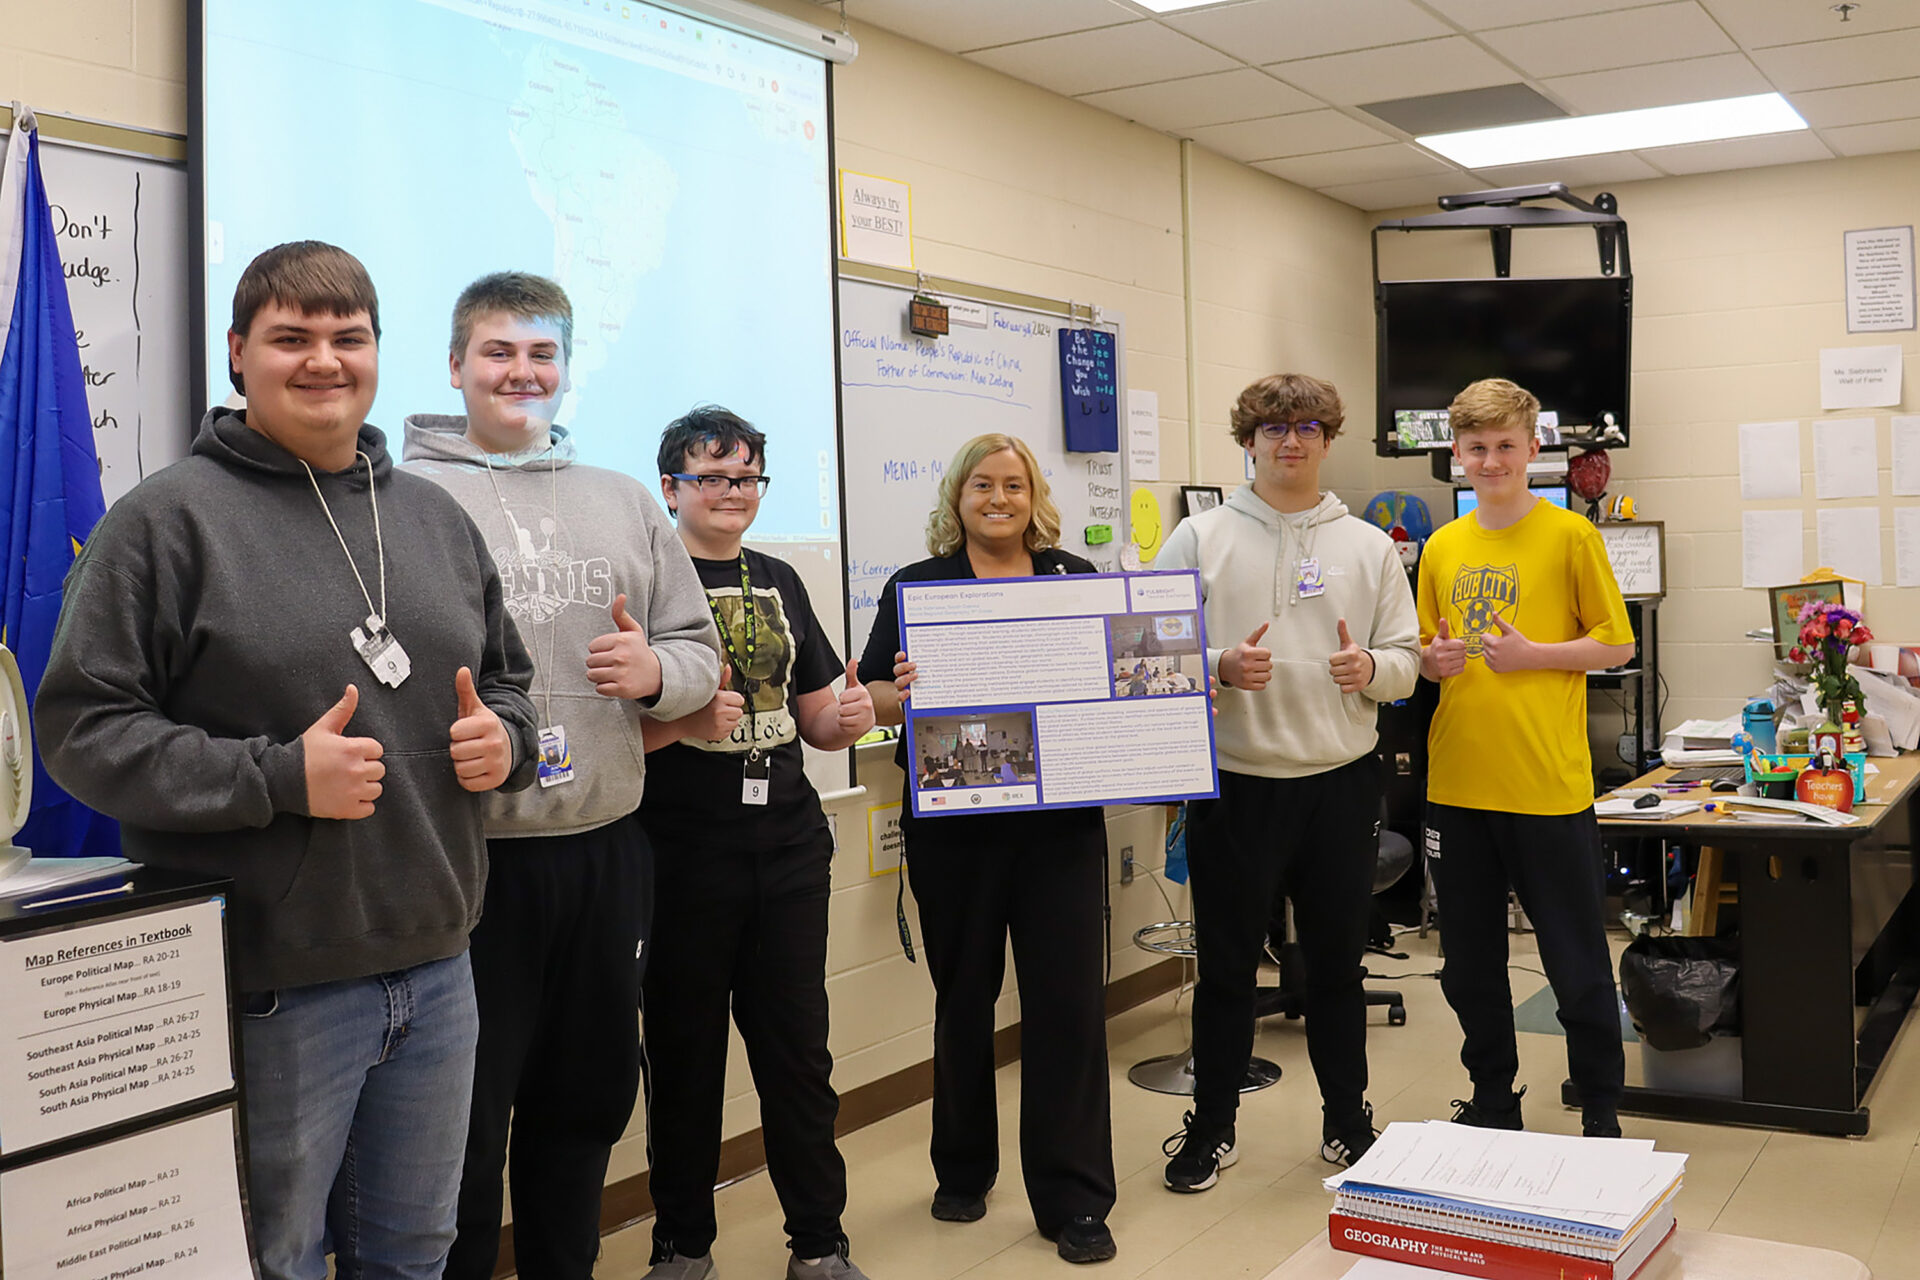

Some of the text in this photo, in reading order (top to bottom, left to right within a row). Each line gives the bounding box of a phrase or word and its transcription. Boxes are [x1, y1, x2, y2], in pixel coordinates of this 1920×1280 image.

[853, 188, 901, 212] Always try
[50, 204, 112, 240] Don't
[852, 214, 903, 234] your BEST!
[62, 257, 120, 287] udge.
[844, 329, 877, 349] Official
[916, 339, 945, 362] People's
[948, 344, 981, 364] Republic
[985, 350, 995, 366] of
[1071, 344, 1088, 356] the
[1075, 332, 1086, 345] Be
[1094, 333, 1107, 345] To
[909, 364, 919, 377] of
[1066, 354, 1095, 371] Change
[1096, 360, 1105, 368] in
[884, 460, 917, 483] MENA
[1087, 459, 1113, 475] TRUST
[1088, 482, 1119, 499] RESPECT
[500, 557, 611, 608] ENNIS
[924, 593, 958, 601] European
[960, 591, 1004, 600] Explorations
[1455, 572, 1515, 603] HUB CITY
[752, 786, 759, 797] 9
[1804, 780, 1843, 791] Teachers
[1813, 791, 1834, 800] have
[25, 924, 192, 968] Map References in Textbook
[41, 973, 74, 987] Europe
[76, 964, 112, 979] Political
[142, 954, 155, 965] RA
[157, 949, 180, 962] 20-21
[43, 980, 181, 1019] Europe Physical 18-19
[26, 1043, 74, 1061] Southeast
[76, 1037, 95, 1049] Asia
[97, 1027, 132, 1043] Political
[134, 1023, 154, 1035] Map
[176, 1010, 200, 1023] 26-27
[28, 1062, 75, 1081] Southeast
[77, 1056, 96, 1068] Asia
[98, 1046, 134, 1063] Physical
[135, 1042, 156, 1053] Map
[178, 1029, 201, 1042] 24-25
[39, 1085, 67, 1099] South
[69, 1078, 88, 1090] Asia
[90, 1068, 126, 1084] Political
[128, 1063, 148, 1075] Map
[171, 1050, 194, 1063] 26-27
[40, 1100, 68, 1115] South
[70, 1094, 89, 1107] Asia
[92, 1084, 127, 1100] Physical
[129, 1079, 149, 1091] Map
[172, 1066, 195, 1079] 24-25
[66, 1168, 180, 1209] Africa Political Map RA 23
[67, 1195, 181, 1237] Africa Physical Map RA 22
[56, 1254, 87, 1270] Middle
[89, 1247, 107, 1259] East
[108, 1235, 142, 1252] Political
[171, 1222, 182, 1233] RA
[184, 1218, 195, 1229] 26
[1344, 1228, 1484, 1259] GEOGRAPHY THE HUMAN AND
[1431, 1250, 1486, 1265] PHYSICAL WORLD
[110, 1263, 144, 1280] Physical
[174, 1250, 186, 1261] RA
[187, 1246, 199, 1257] 24
